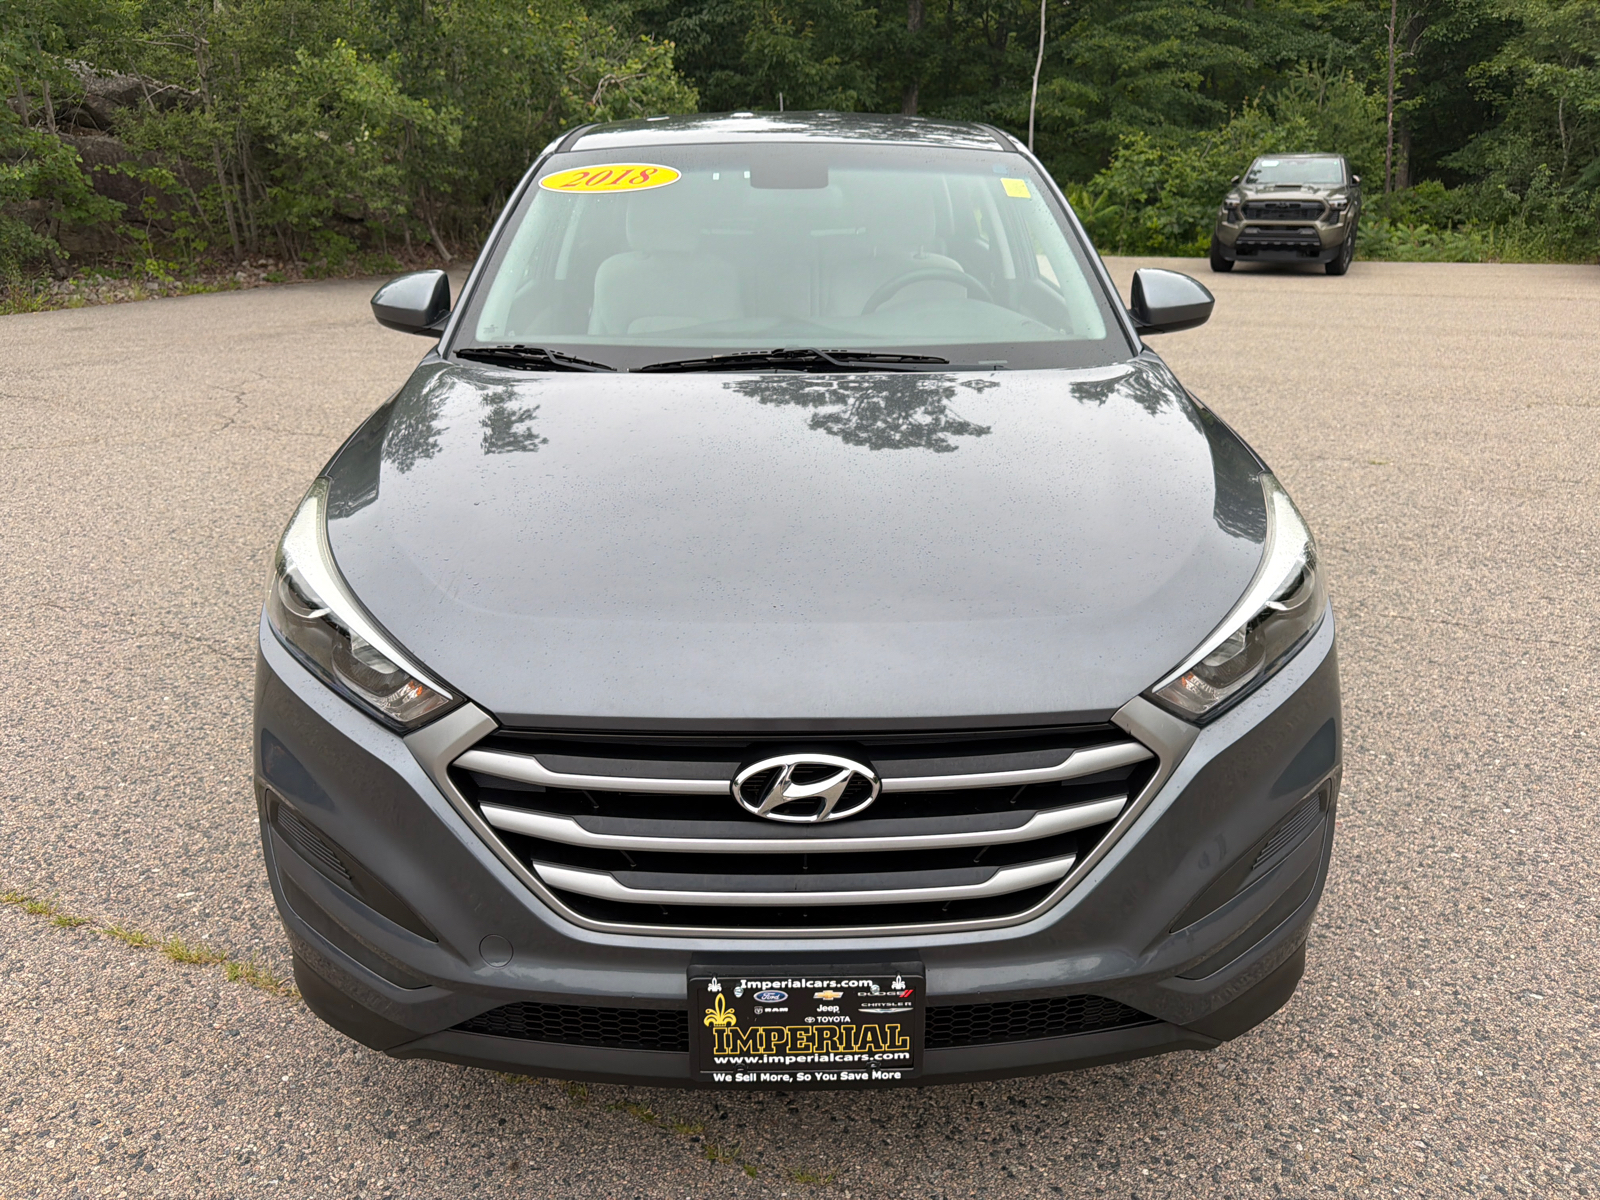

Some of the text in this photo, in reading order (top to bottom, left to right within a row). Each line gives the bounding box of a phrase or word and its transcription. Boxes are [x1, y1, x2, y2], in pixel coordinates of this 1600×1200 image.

[559, 168, 658, 188] 2018
[740, 978, 872, 990] Imperialcars.com
[816, 1004, 840, 1013] Jeep
[713, 1024, 910, 1054] IMPERIAL
[714, 1052, 910, 1064] www.imperialcars.com
[713, 1070, 902, 1083] We Sell More, So You Save More
